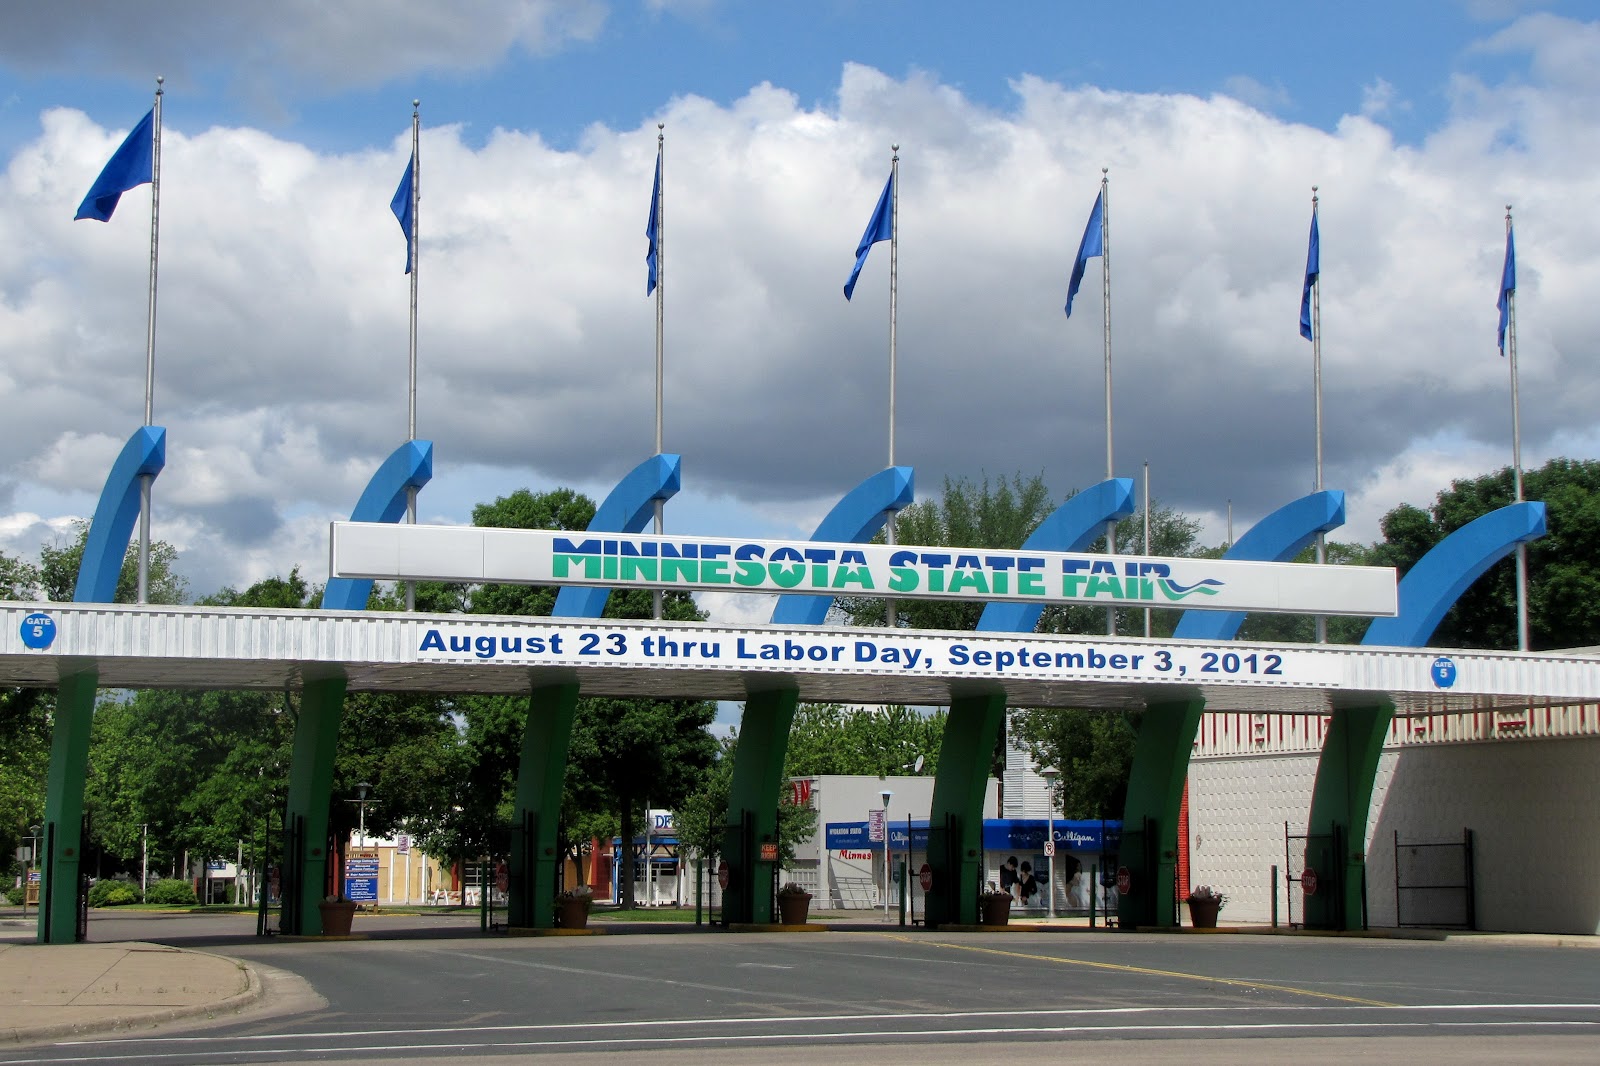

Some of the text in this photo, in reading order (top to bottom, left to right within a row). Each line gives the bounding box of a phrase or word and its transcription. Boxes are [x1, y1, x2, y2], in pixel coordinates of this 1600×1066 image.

[552, 537, 1176, 602] MINNESOTA STATE FAIR
[26, 617, 51, 625] GATE
[33, 626, 43, 637] 5
[419, 629, 1284, 676] August 23 thru Labor Day, September 3, 2012
[1440, 668, 1448, 678] 5
[655, 814, 673, 829] DF
[1053, 830, 1095, 846] Culligan
[761, 852, 778, 860] RIGHT
[920, 871, 931, 883] STOP
[1117, 875, 1129, 886] STOP
[1302, 876, 1315, 886] STOP
